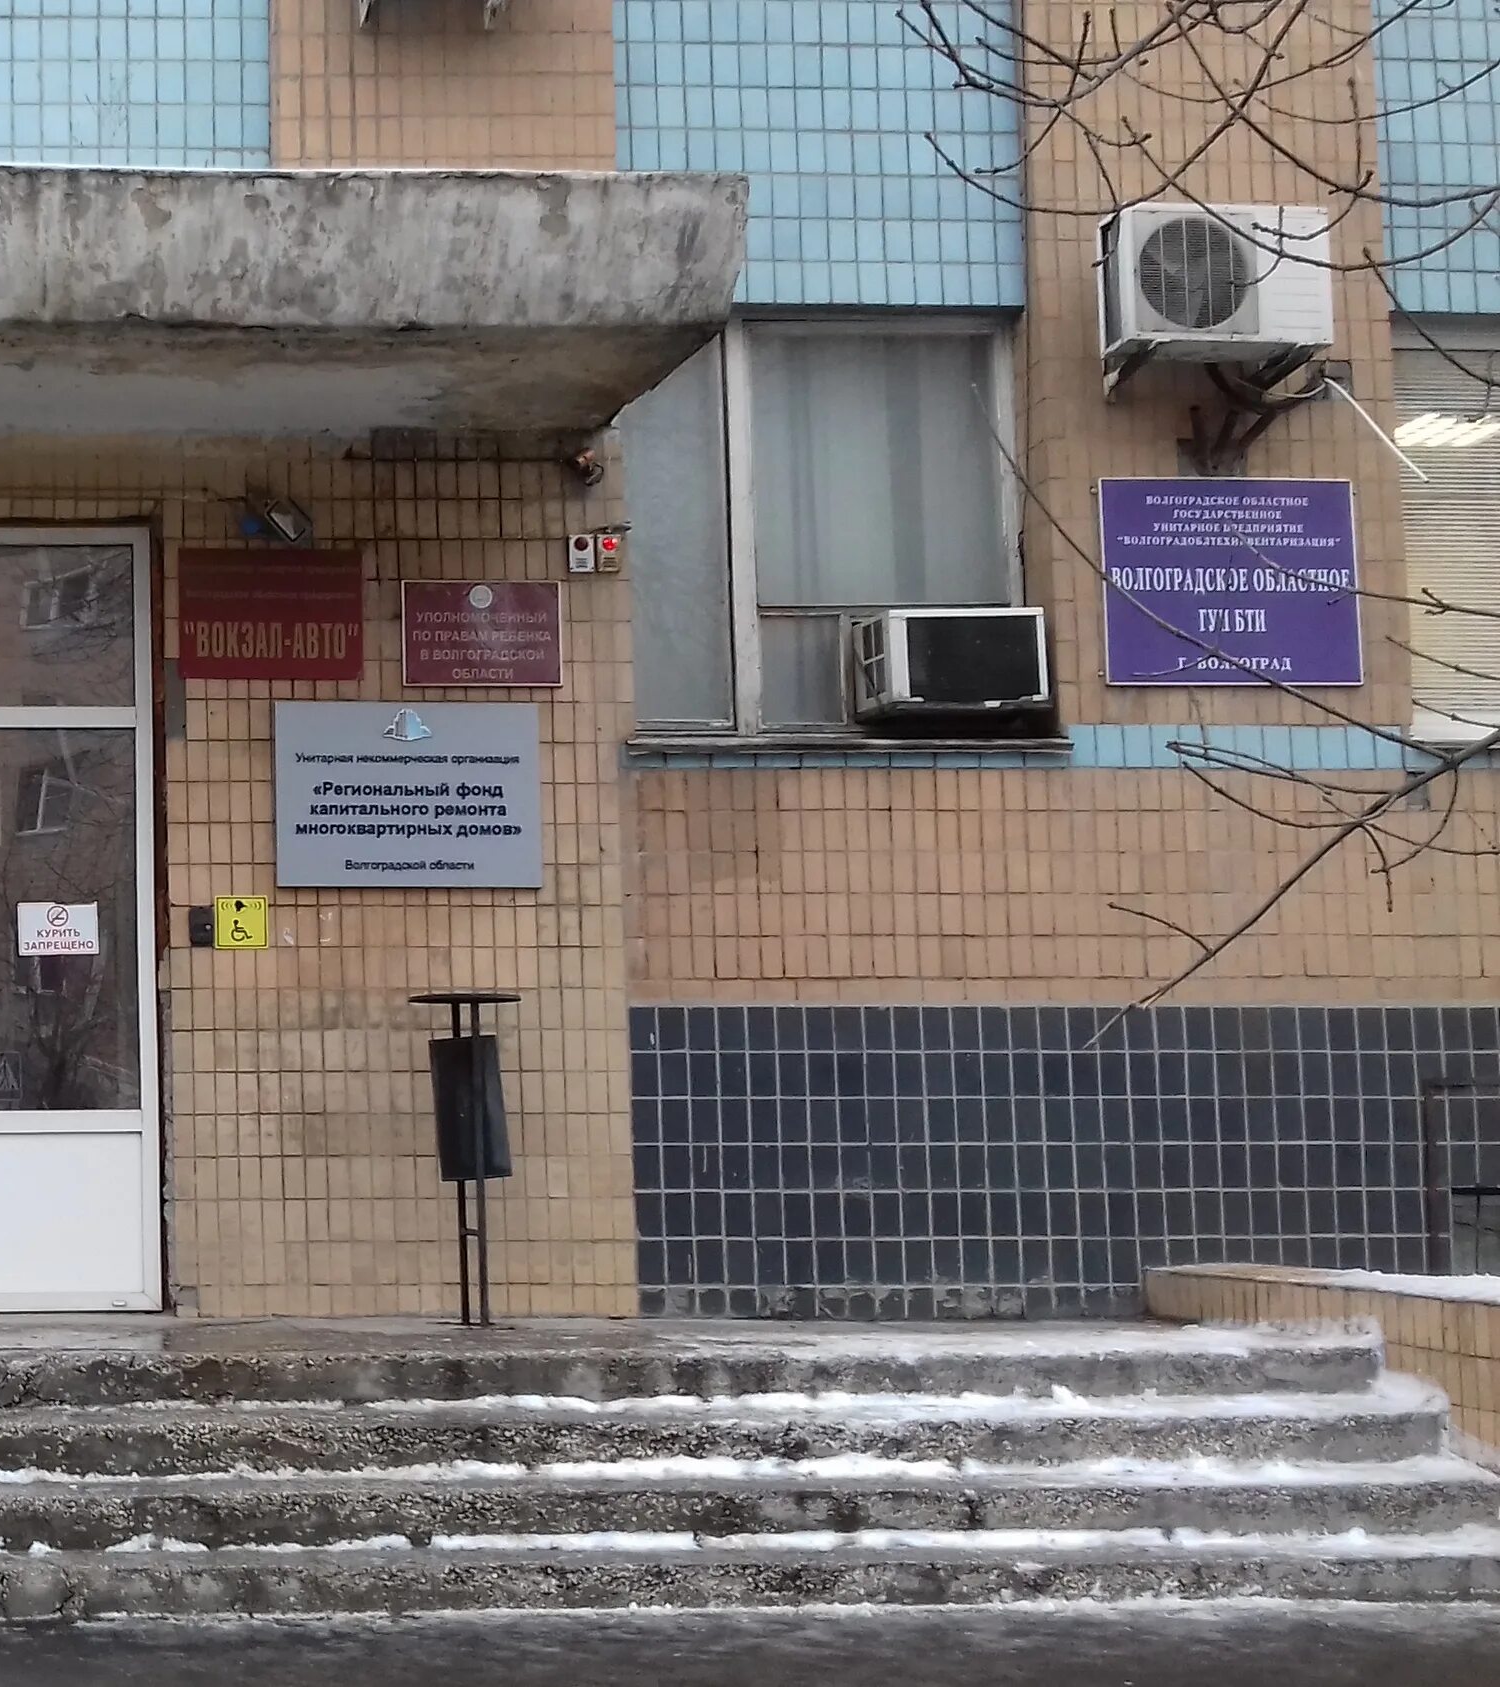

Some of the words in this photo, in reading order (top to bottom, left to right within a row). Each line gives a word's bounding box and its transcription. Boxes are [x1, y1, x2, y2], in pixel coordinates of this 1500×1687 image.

[1145, 495, 1240, 506] ВОЛГОГРАДСКОЕ
[1242, 496, 1309, 507] ОБЛАСТНОЕ
[1172, 509, 1282, 520] ГОСУДАРСТВЕННОЕ
[1153, 522, 1221, 532] УНИТАРНОЕ
[1111, 567, 1249, 595] ВОЛГОГРАДСКОЕ
[1253, 568, 1350, 592] ОБЛАСТНОЕ
[416, 612, 547, 623] УПОЛНОМОЧЕННЫЙ
[1234, 609, 1267, 632] БТИ
[412, 631, 432, 642] ПО
[435, 631, 489, 642] ПРАВАМ
[491, 631, 552, 642] РЕБЕНКА
[420, 650, 429, 660] В
[432, 649, 545, 661] ВОЛГОГРАДСКОЙ
[452, 668, 514, 680] ОБЛАСТИ
[295, 753, 354, 765] Унитарная
[356, 755, 448, 765] некоммерческая
[451, 755, 520, 765] организация
[312, 781, 450, 797] «Региональный
[456, 782, 504, 799] фонд
[310, 804, 429, 816] капитального
[434, 804, 507, 819] ремонта
[295, 823, 452, 839] многоквартирных
[456, 823, 522, 838] домов»
[345, 860, 426, 871] Волгоградской
[430, 860, 475, 871] области
[36, 928, 81, 938] КУРИТЬ
[23, 941, 94, 951] ЗАПРЕЩЕНО
